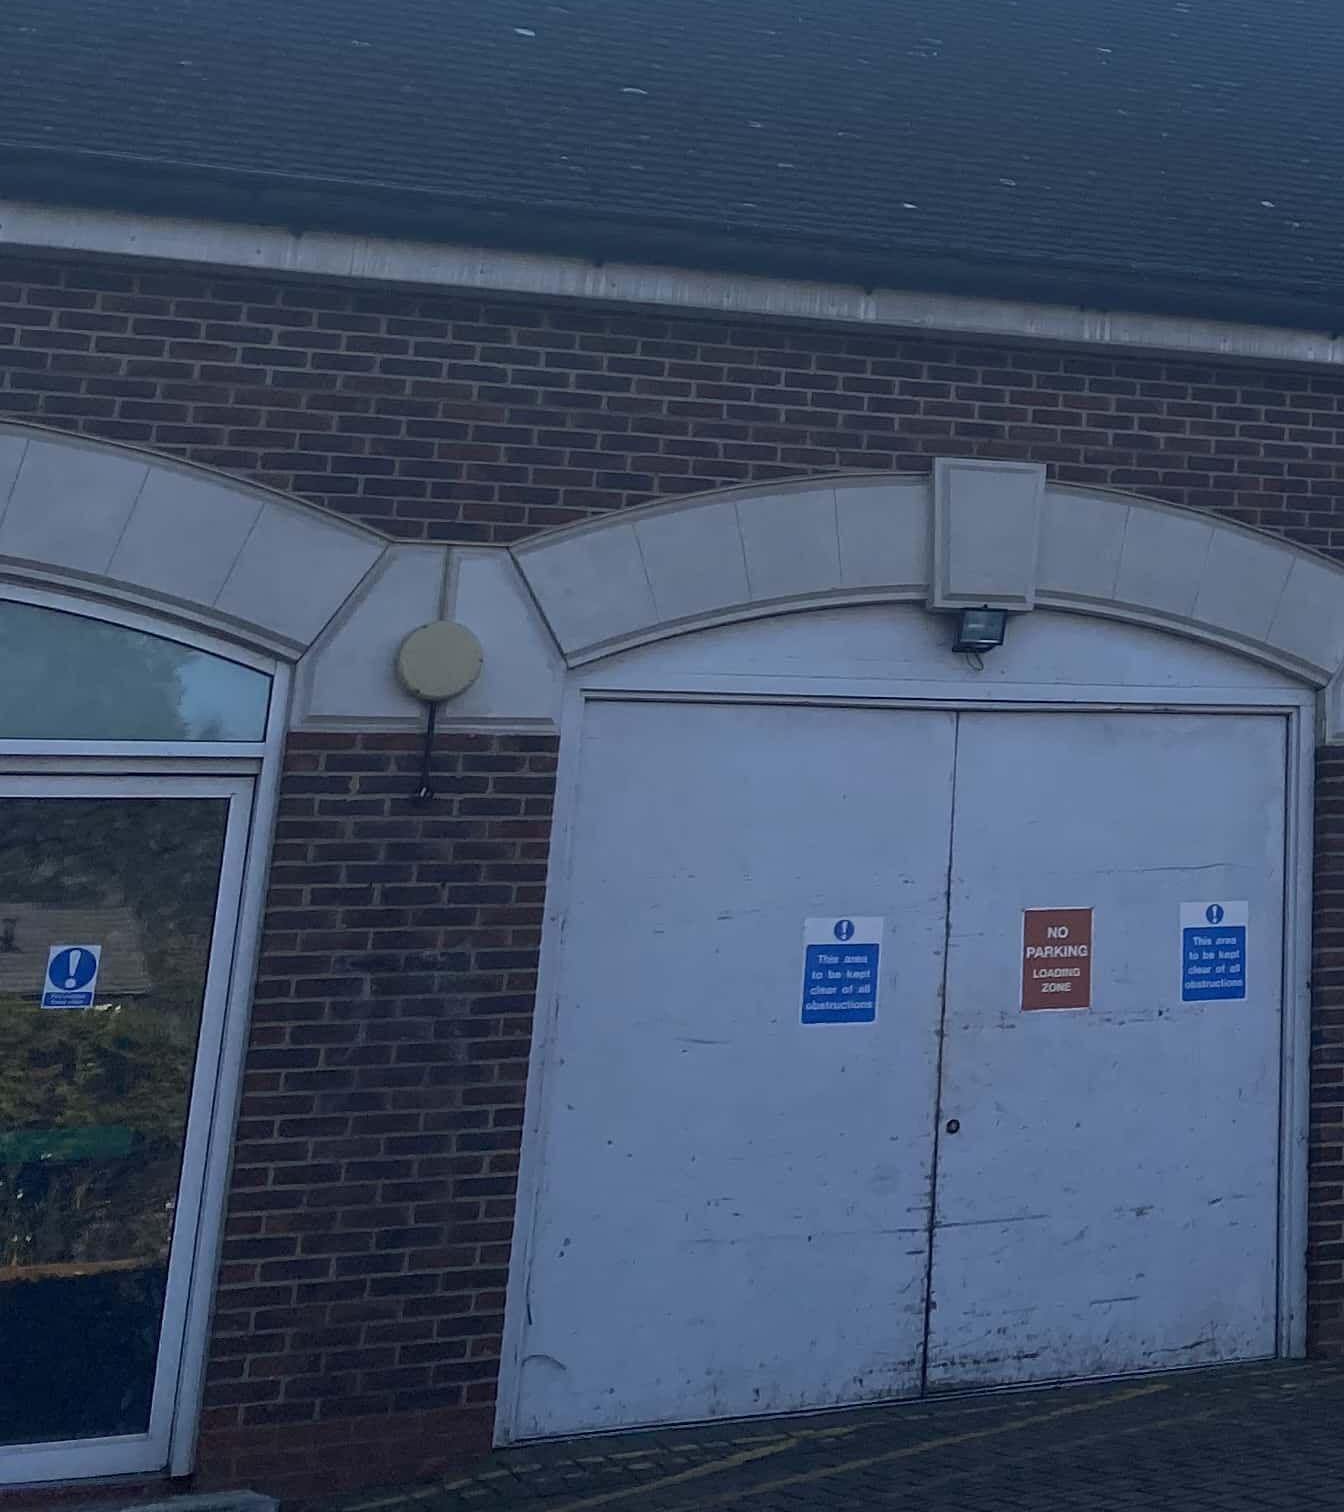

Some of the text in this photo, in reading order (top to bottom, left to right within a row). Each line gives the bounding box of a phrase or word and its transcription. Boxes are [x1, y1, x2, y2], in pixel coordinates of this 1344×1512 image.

[1047, 926, 1069, 938] NO
[1192, 936, 1237, 946] This area
[1026, 945, 1089, 958] PARKING
[1188, 949, 1240, 960] to be kept
[817, 954, 868, 964] This area
[811, 969, 871, 980] to be kept
[1032, 968, 1081, 979] LOADING
[1187, 965, 1211, 975] clear
[1215, 963, 1226, 974] of
[809, 983, 871, 995] clear of all
[1041, 982, 1072, 993] ZONE
[1184, 979, 1243, 990] obstructions
[805, 1000, 873, 1010] obstructions
